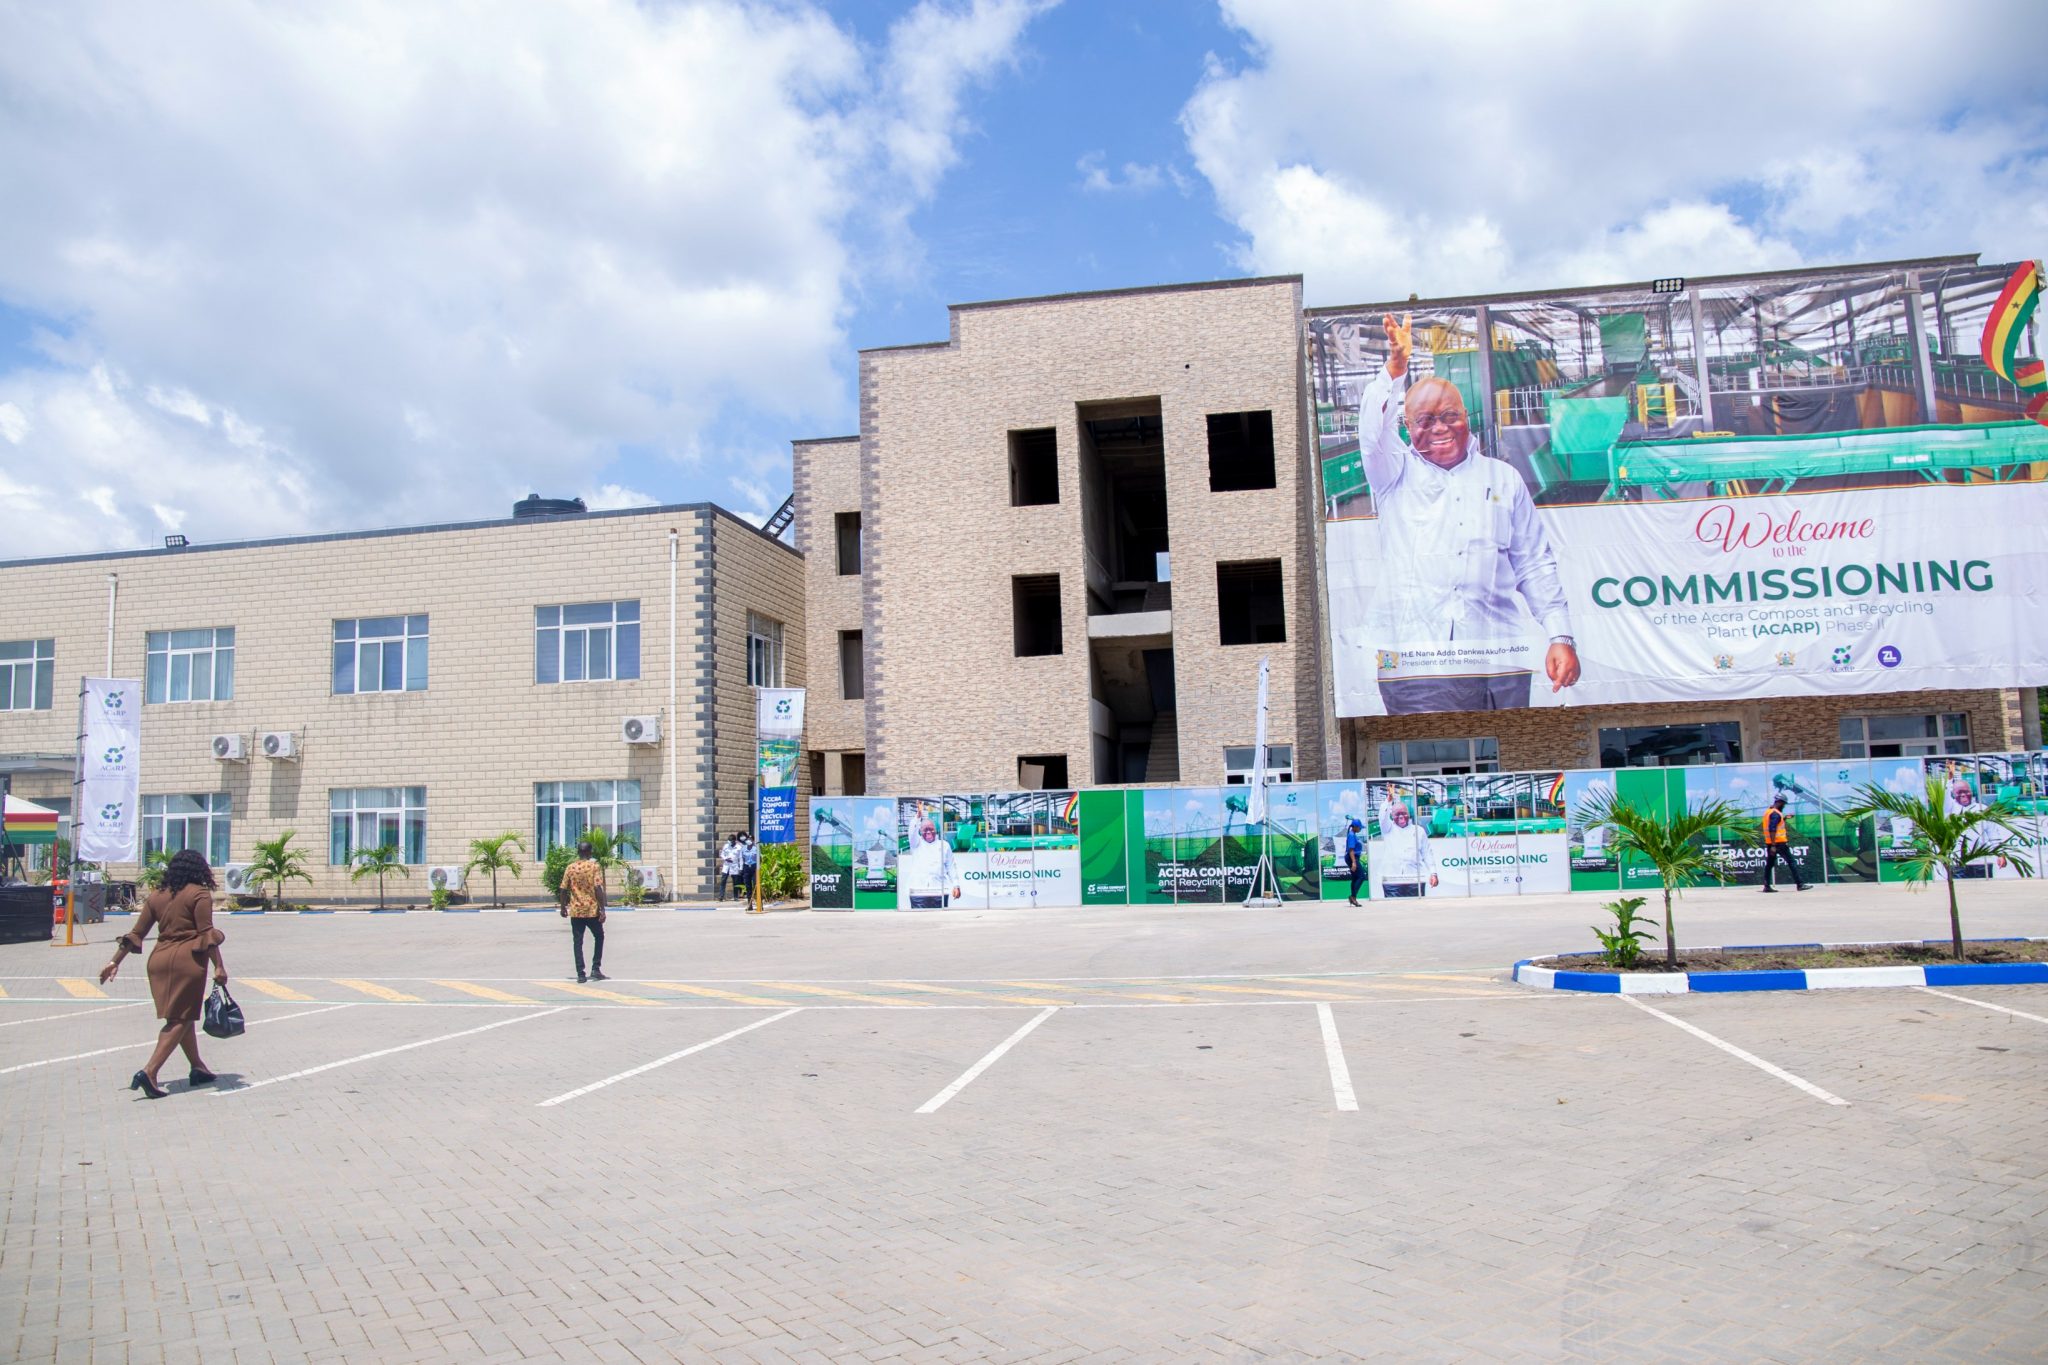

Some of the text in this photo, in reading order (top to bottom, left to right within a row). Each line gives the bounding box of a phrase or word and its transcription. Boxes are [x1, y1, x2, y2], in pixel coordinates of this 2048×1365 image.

[1695, 504, 1876, 553] Welcome
[1772, 544, 1806, 558] to the
[1591, 559, 1993, 609] COMMISSIONING
[1654, 601, 1934, 626] of the Accra Compost and Recycling
[1708, 626, 1748, 638] Plant
[1752, 622, 1820, 638] (ACARP)
[1826, 620, 1872, 633] Phase
[1486, 646, 1530, 656] Akufo-Addo
[1746, 846, 1809, 858] COST
[1442, 854, 1548, 866] COMMISSIONING
[1726, 859, 1766, 869] Recyclin
[1777, 857, 1804, 866] Plnt
[964, 870, 1061, 880] COMMISSIONING
[1158, 866, 1258, 878] ACCRA COMPOST
[814, 884, 837, 892] Plant
[1158, 876, 1254, 888] and Recycling Plant
